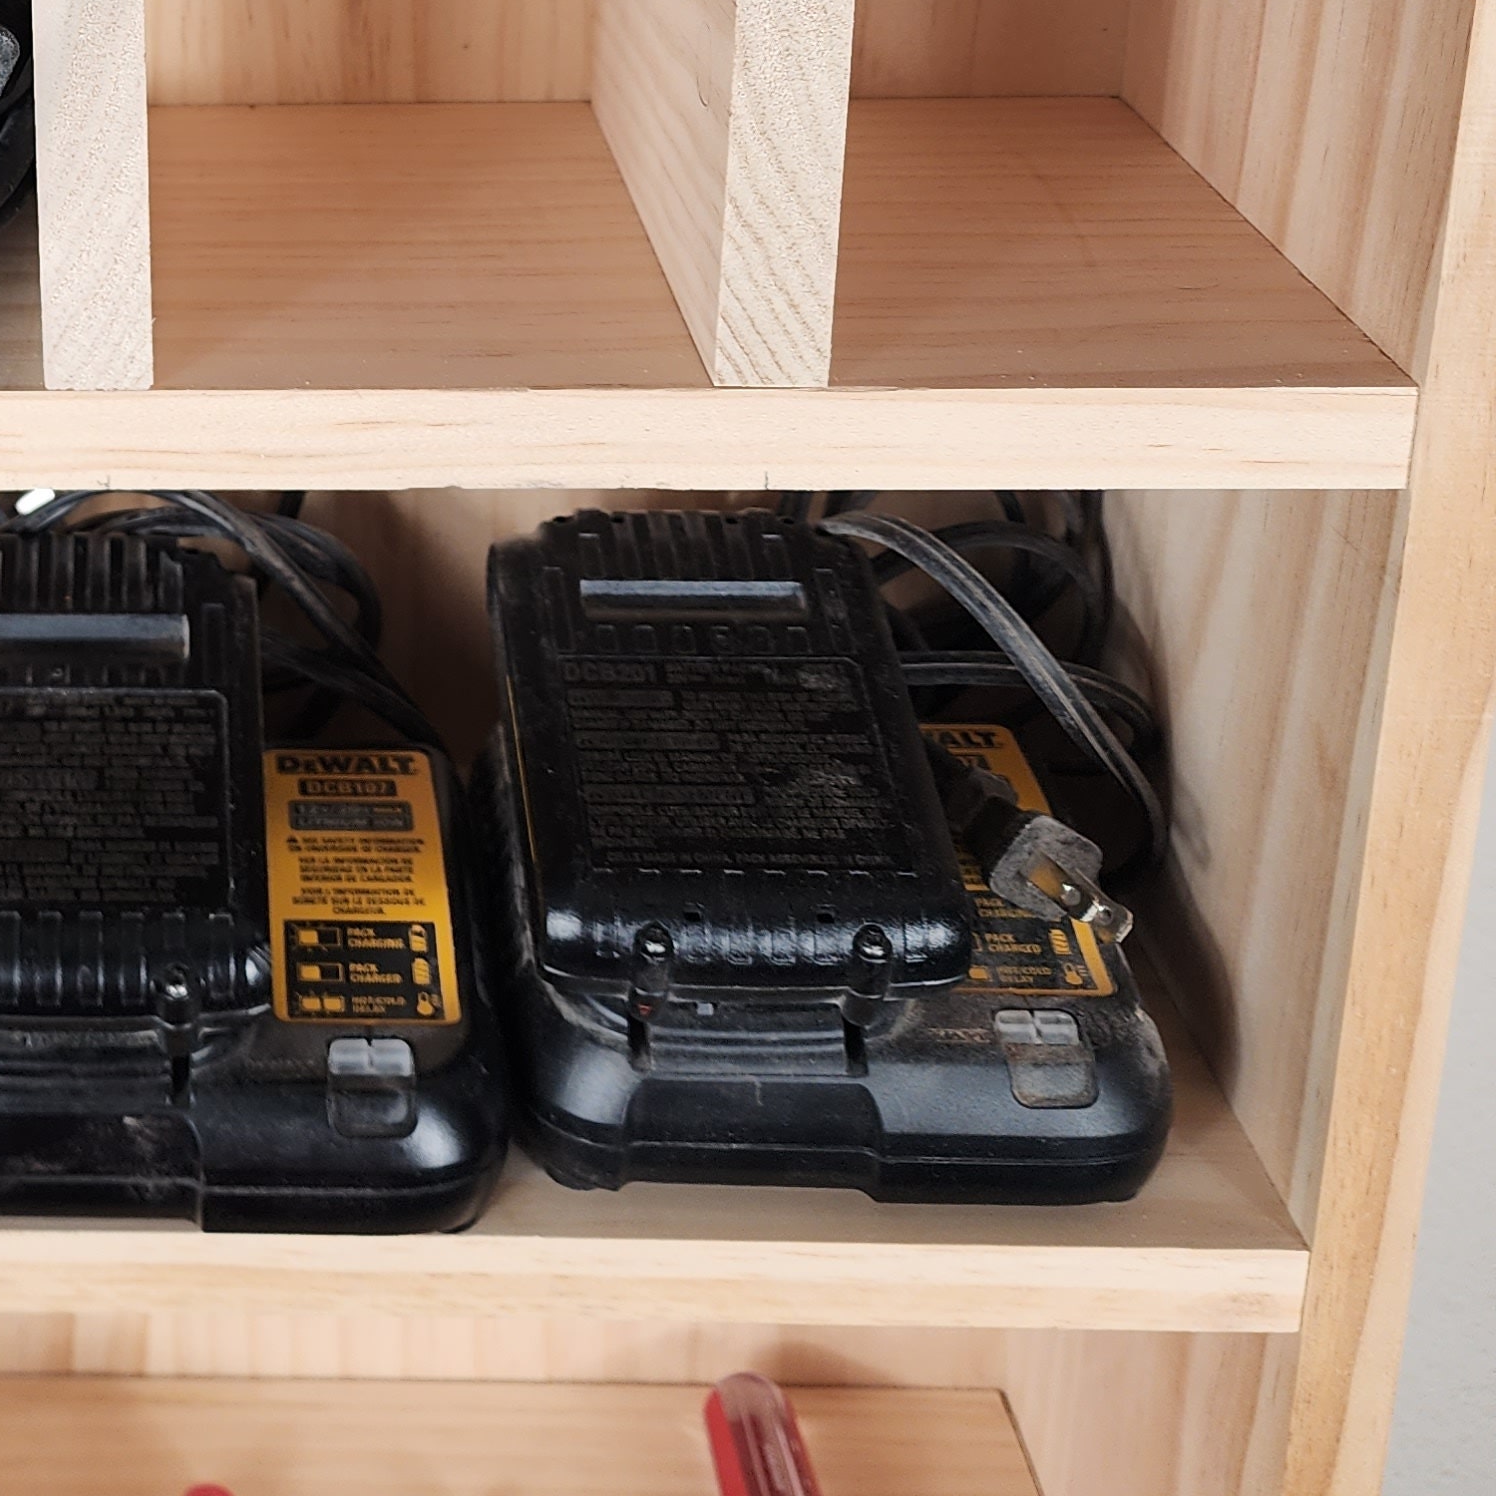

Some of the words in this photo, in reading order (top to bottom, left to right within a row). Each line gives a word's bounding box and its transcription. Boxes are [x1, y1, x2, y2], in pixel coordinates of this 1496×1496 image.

[347, 927, 376, 937] PACK
[984, 933, 1016, 943] PACK
[349, 962, 379, 973] PACK
